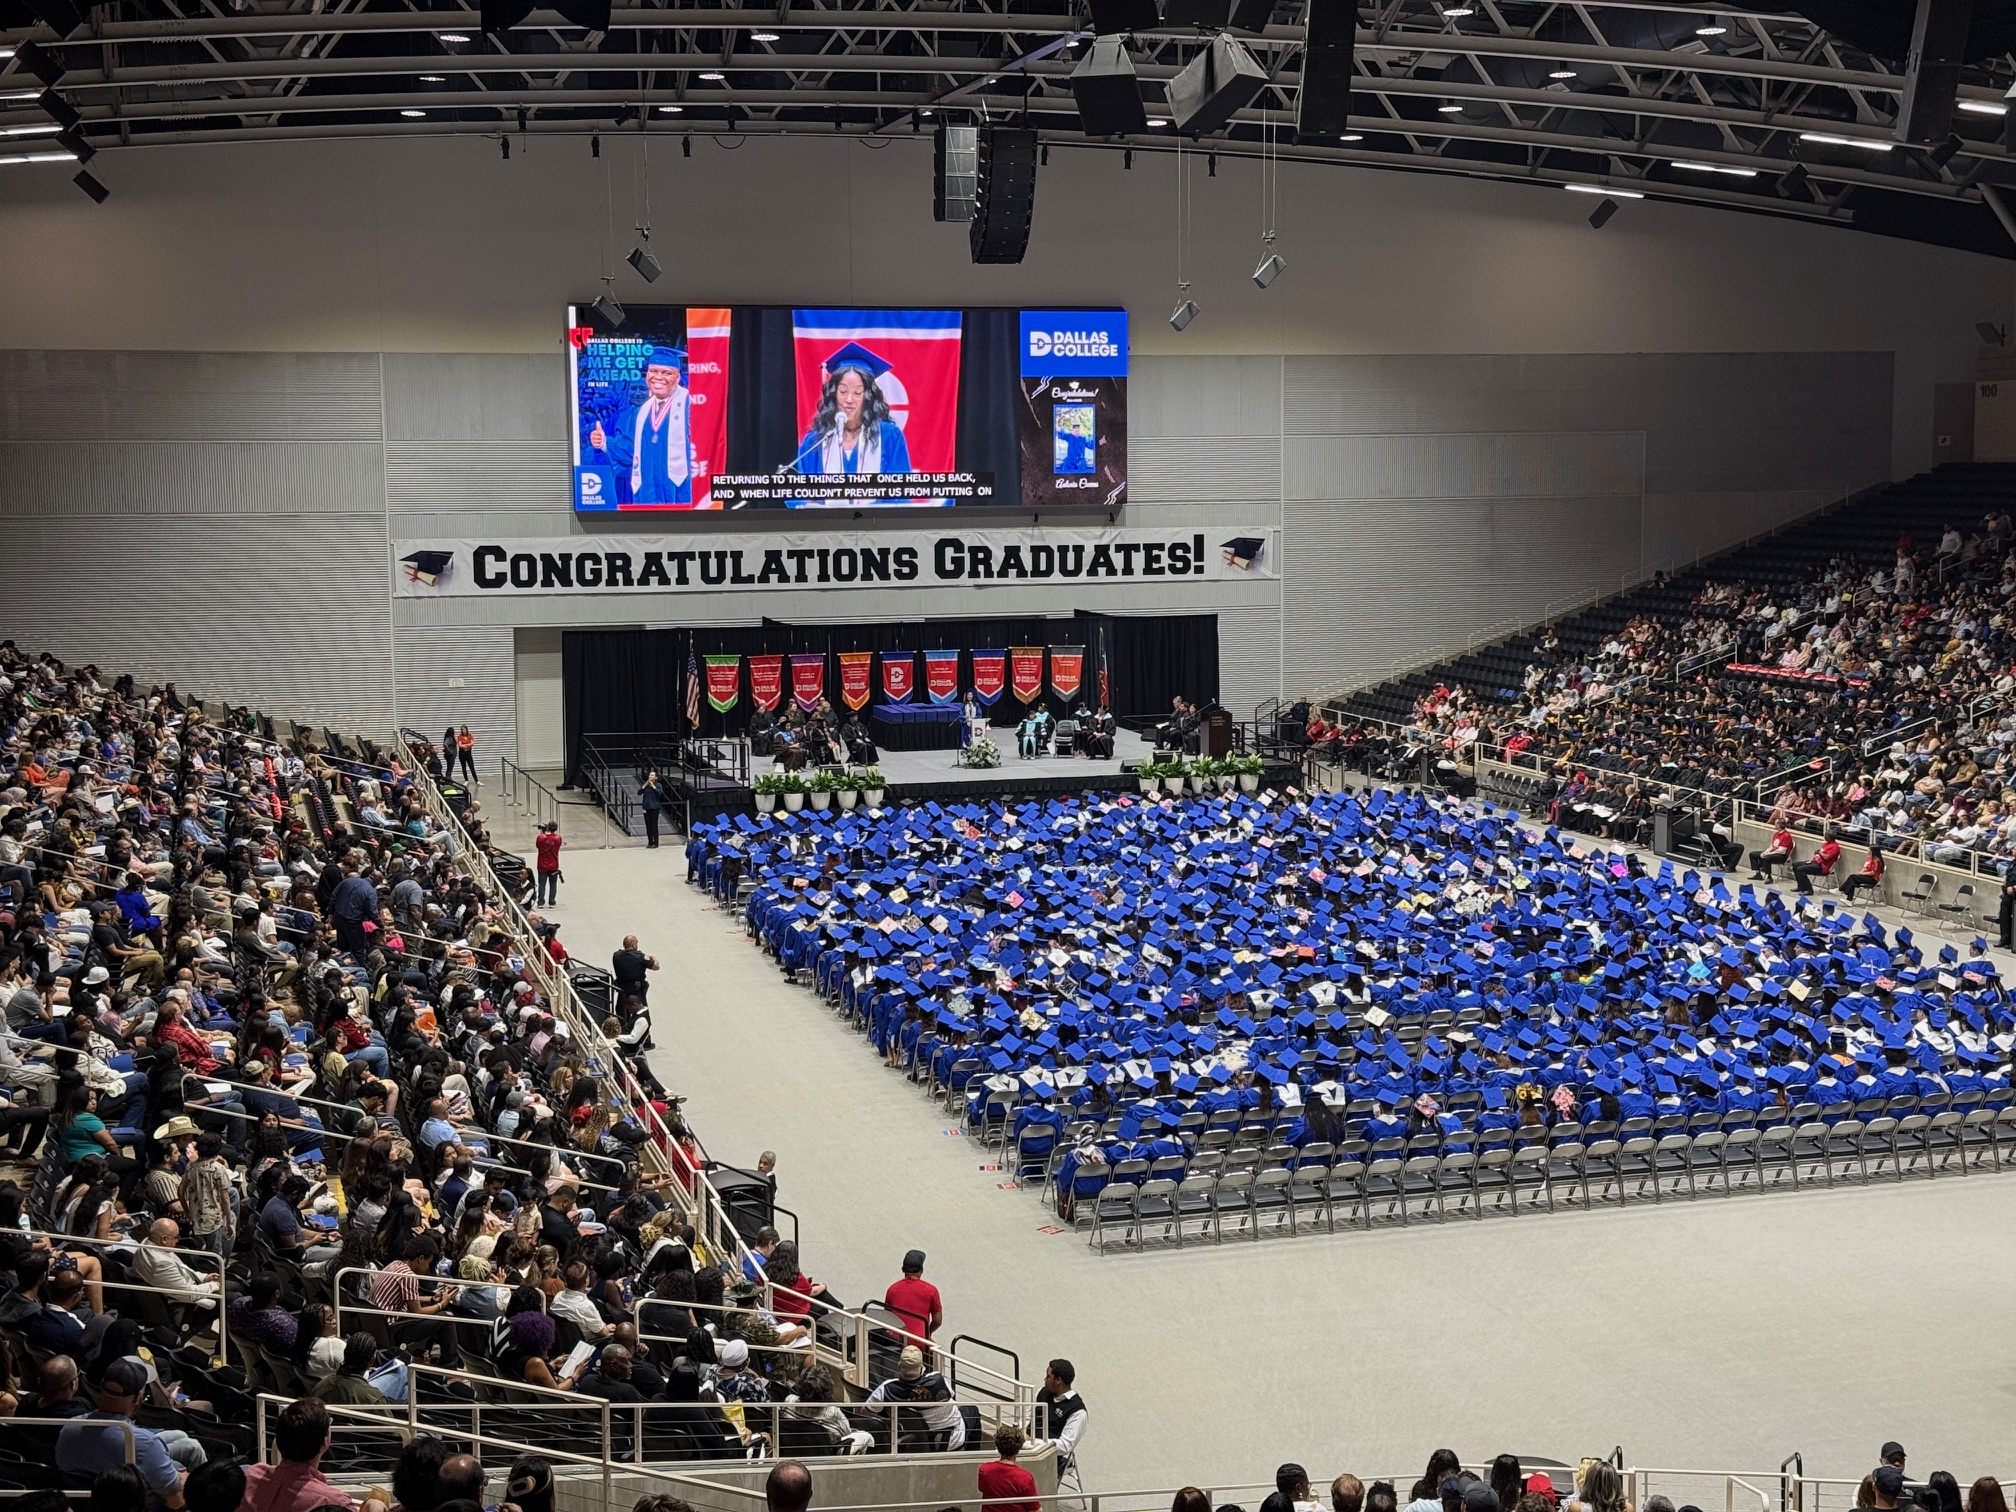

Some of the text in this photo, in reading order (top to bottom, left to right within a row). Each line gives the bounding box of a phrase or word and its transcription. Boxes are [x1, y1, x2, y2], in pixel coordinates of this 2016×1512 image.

[1053, 331, 1109, 344] DALLAS
[587, 344, 654, 356] HELPING
[1053, 344, 1118, 357] COLLEGE
[587, 357, 645, 369] ME GET
[588, 369, 642, 381] AHEAD
[1979, 384, 1998, 398] 100
[713, 473, 976, 485] RETURNING TO THE THINGS THAT ONCE HELD US BACK,
[713, 486, 992, 498] AND WHEN LIFE COULDN'T PREVENT US FROM PUTTING ON
[472, 533, 1205, 589] CONGRATULATIONS GRADUATES!
